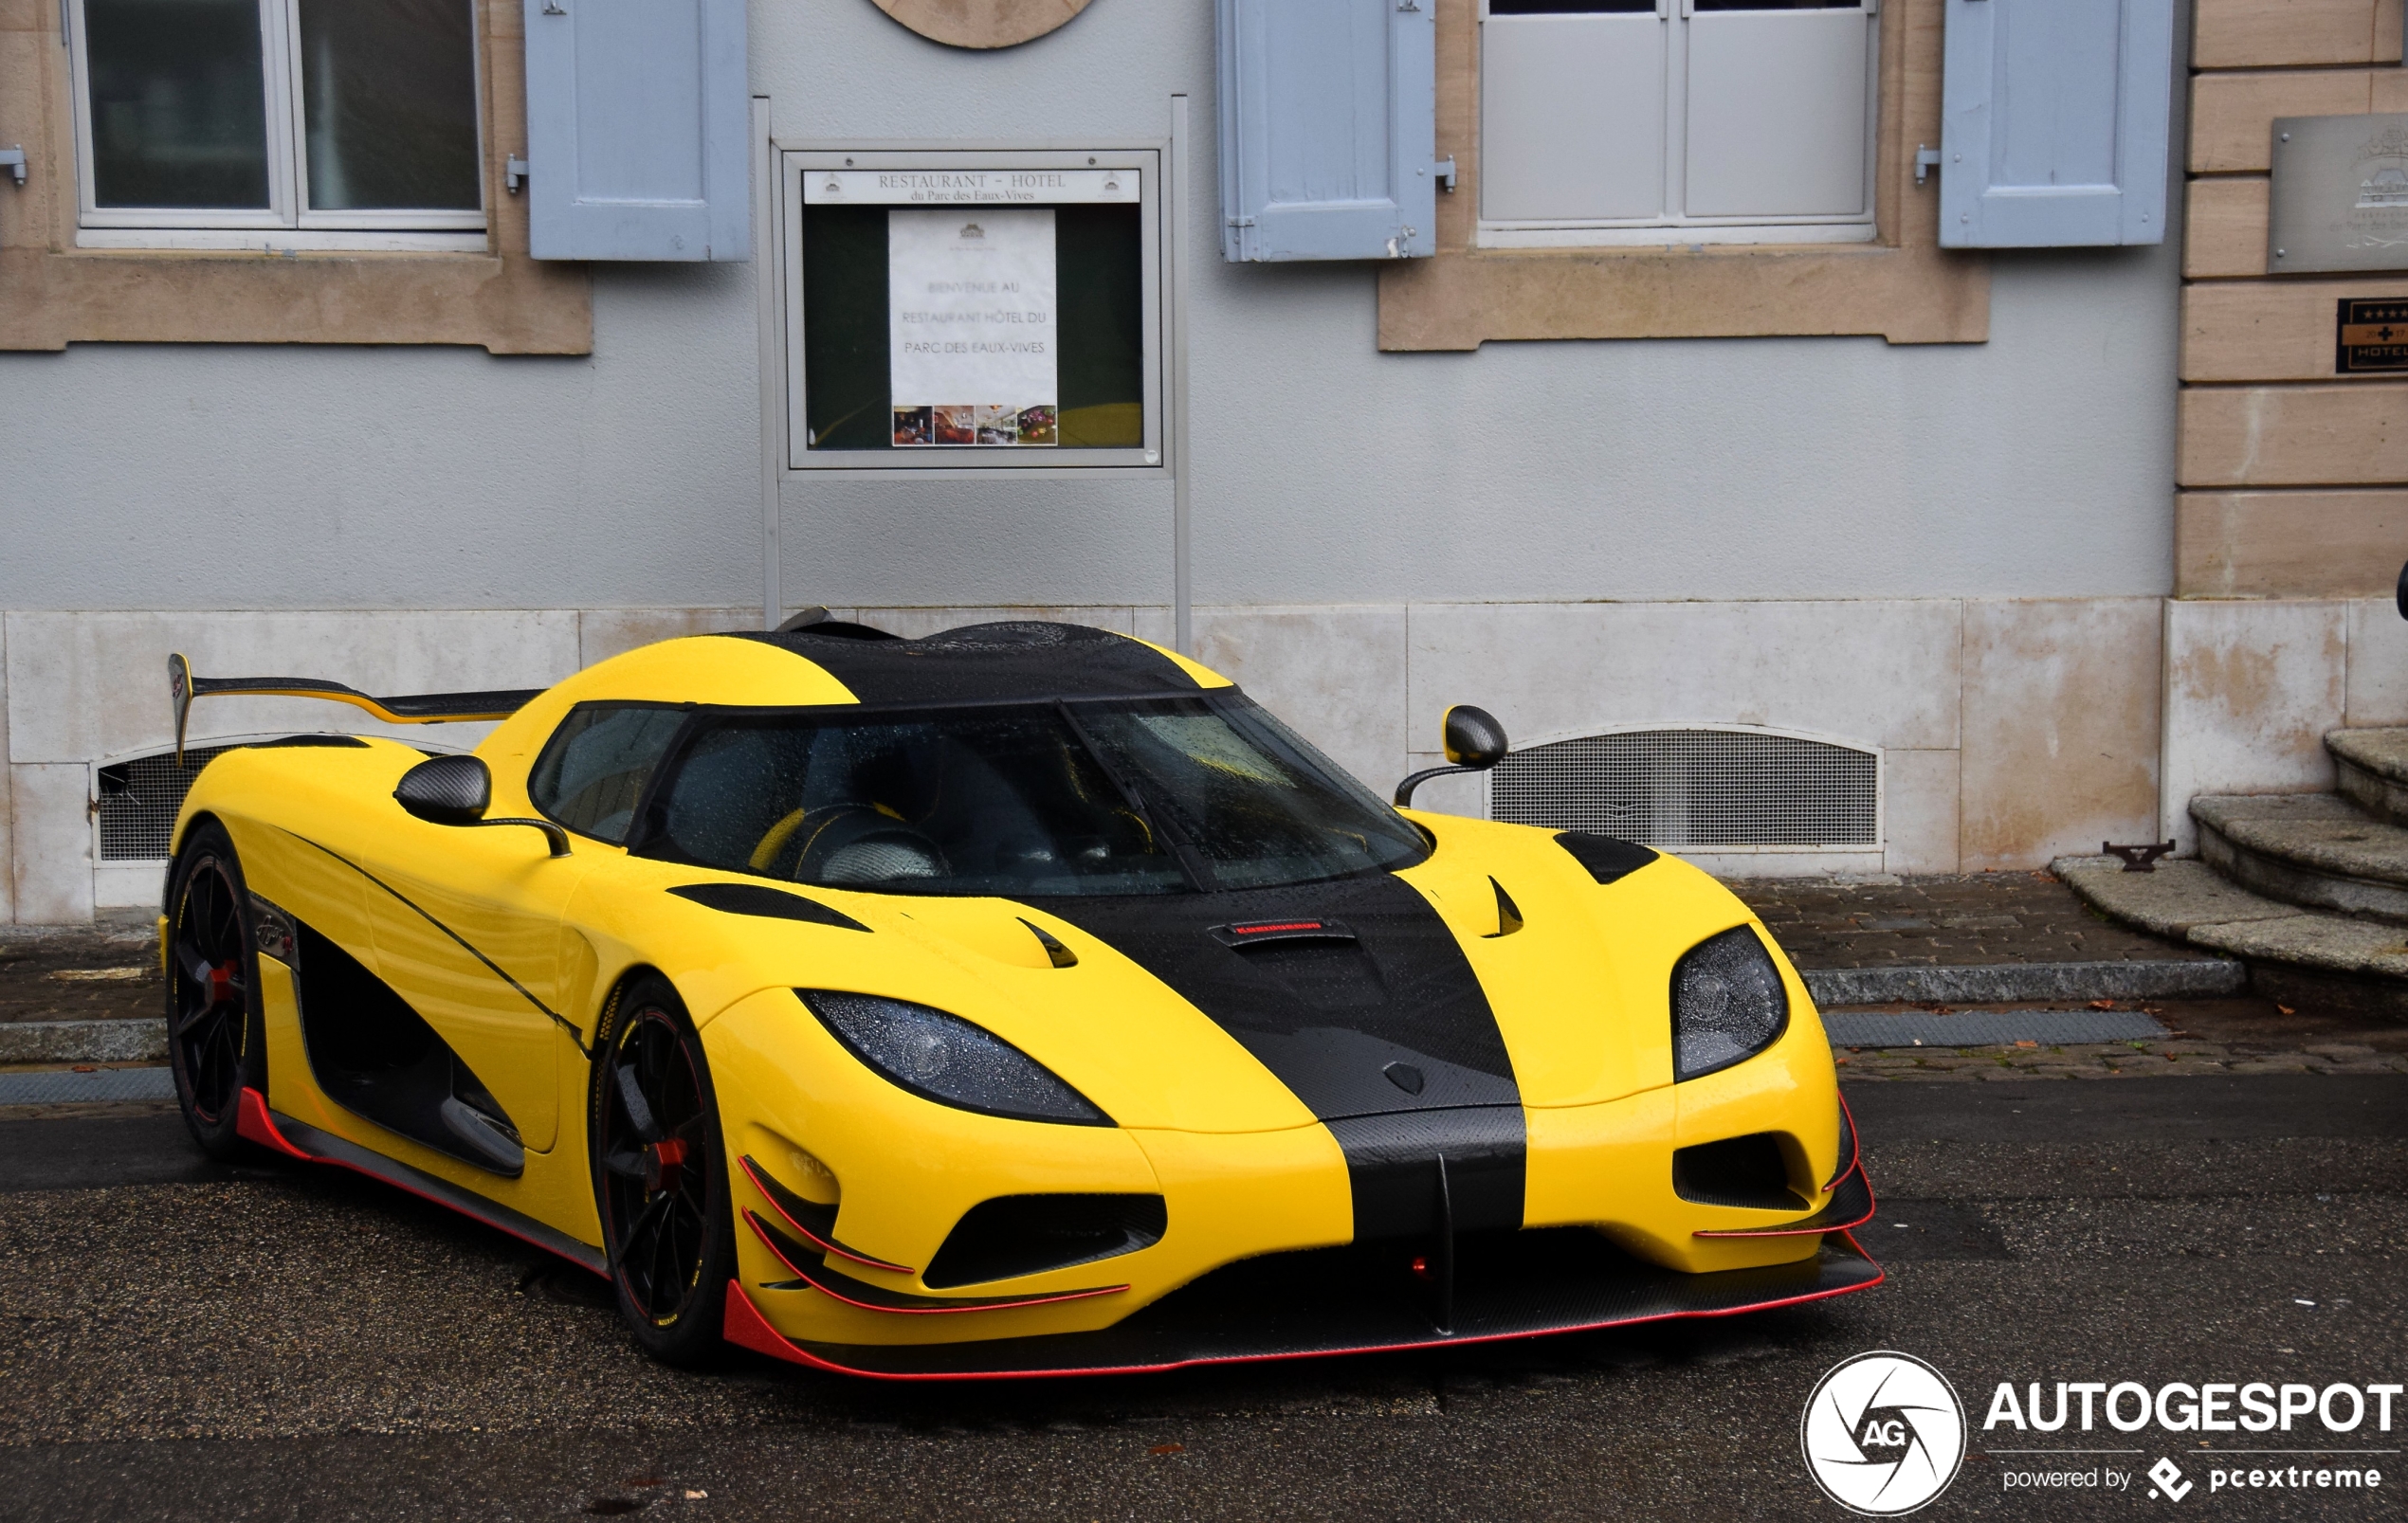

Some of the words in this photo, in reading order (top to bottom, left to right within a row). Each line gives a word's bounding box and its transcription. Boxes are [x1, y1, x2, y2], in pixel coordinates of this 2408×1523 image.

[879, 174, 987, 190] RESTAURANT
[1012, 173, 1067, 189] HOTEL
[910, 190, 925, 202] du
[927, 190, 950, 202] Parc
[953, 190, 972, 202] des
[974, 190, 1034, 202] Eaux-Vives
[928, 282, 997, 294] BIENVENUE
[1001, 282, 1020, 294] AU
[902, 312, 980, 324] RESTAURANT
[984, 309, 1024, 324] HÔTEL
[1028, 311, 1047, 323] DU
[903, 342, 941, 354] PARC
[944, 342, 968, 354] DES
[971, 341, 1046, 354] EAUX-VIVES
